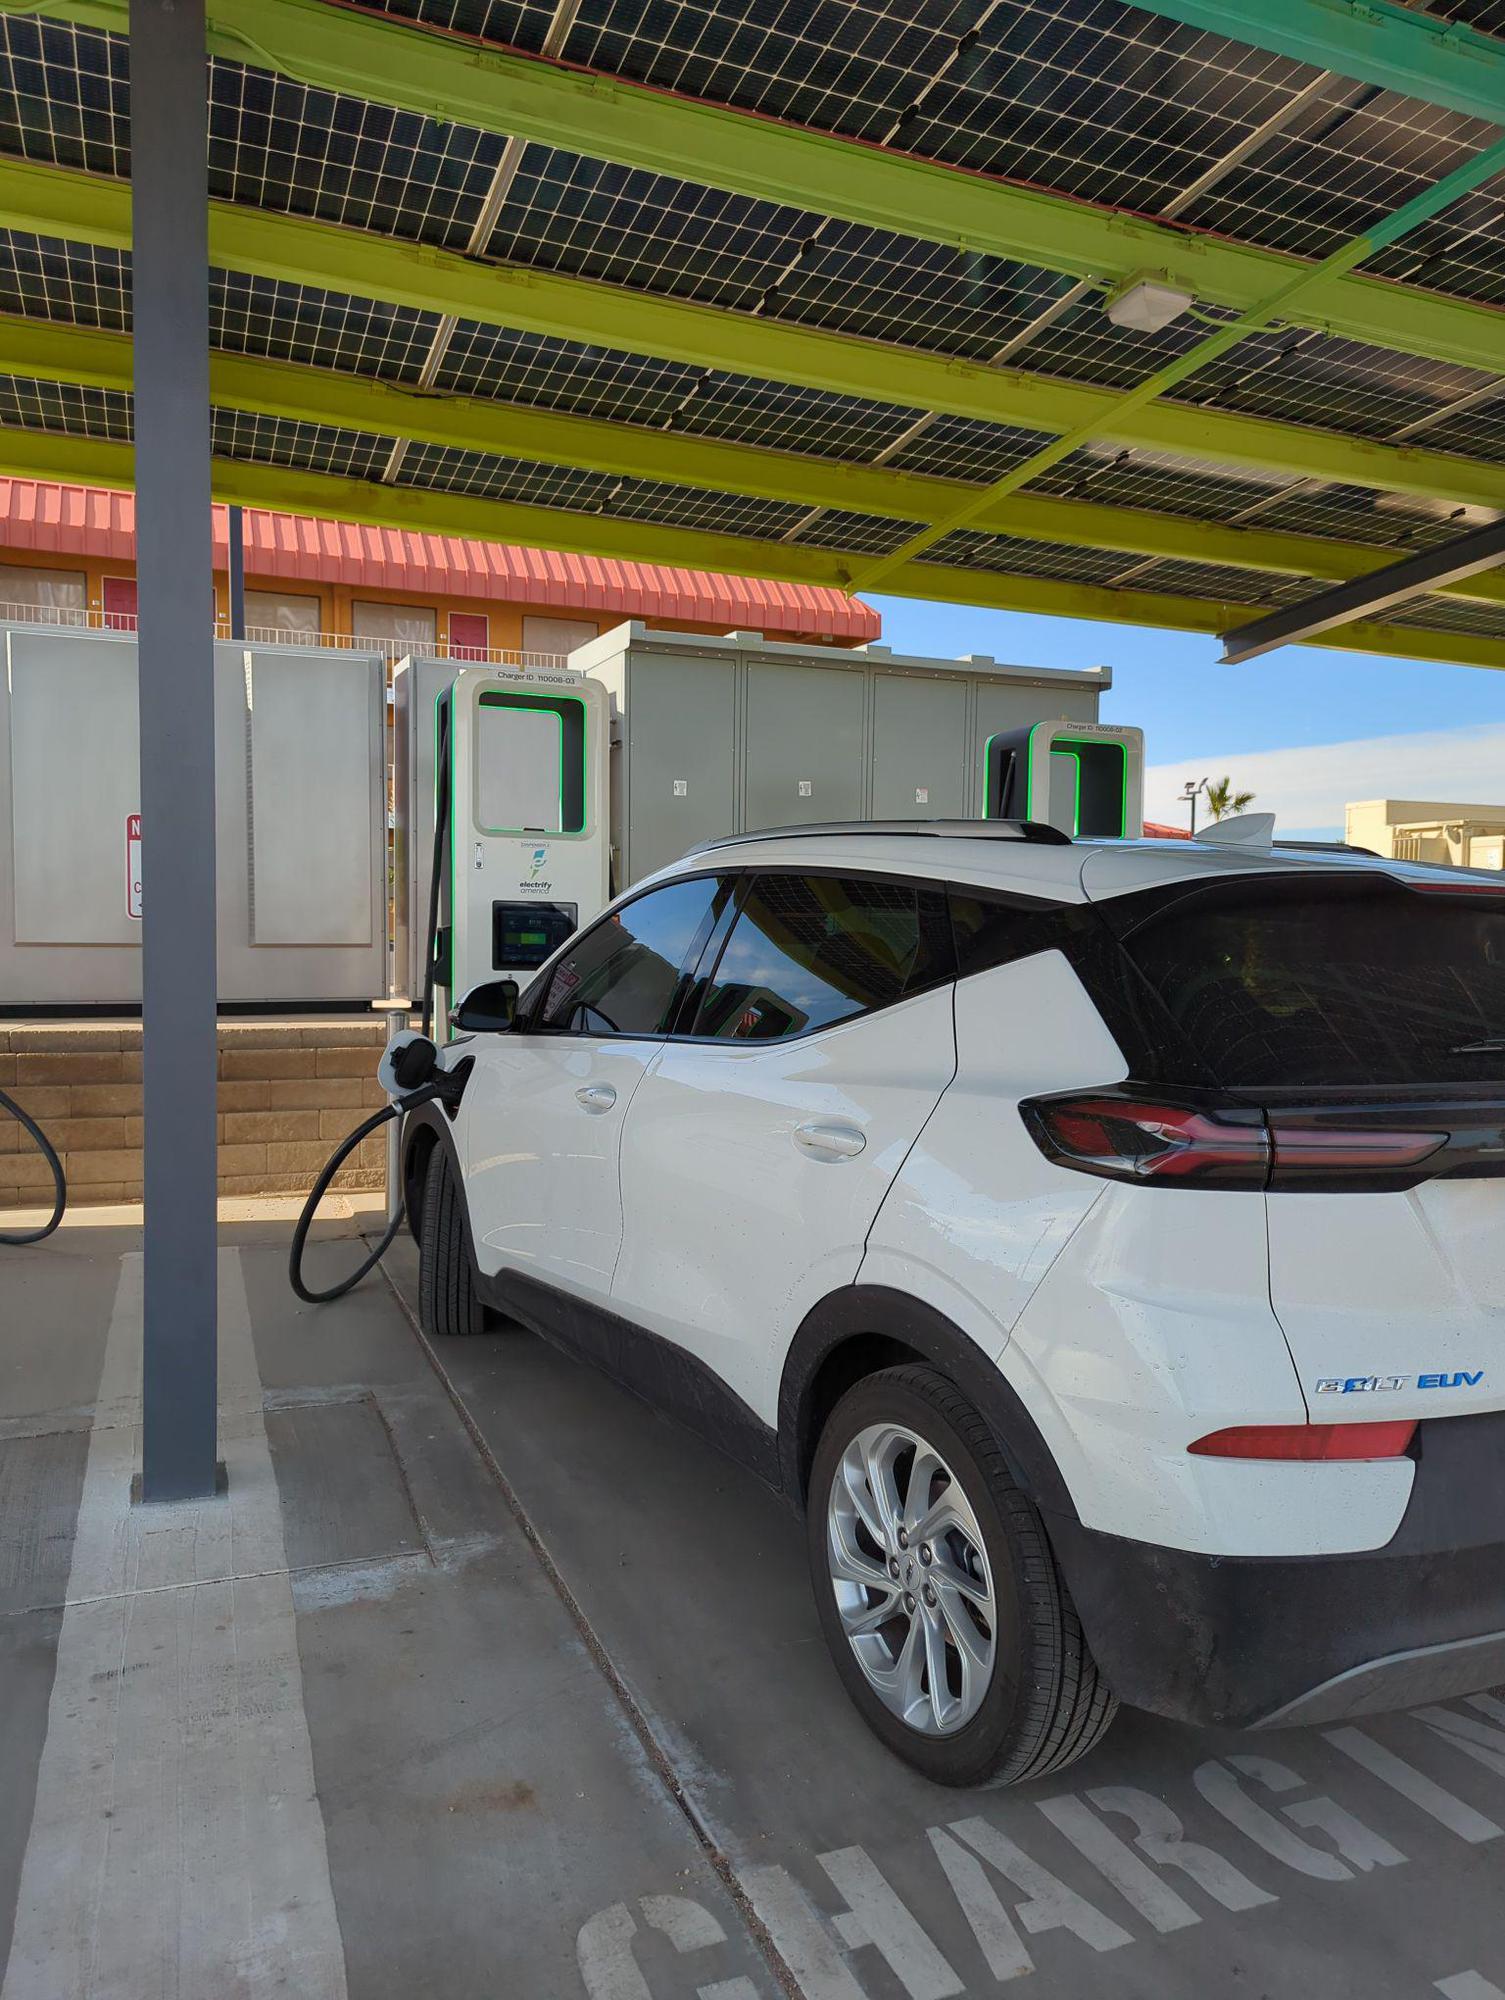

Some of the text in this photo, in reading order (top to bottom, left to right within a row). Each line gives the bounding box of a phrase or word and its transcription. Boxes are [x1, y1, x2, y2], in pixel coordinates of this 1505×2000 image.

[497, 671, 525, 680] Charger
[519, 881, 552, 890] electrify
[1314, 1370, 1484, 1394] BOLT EUV
